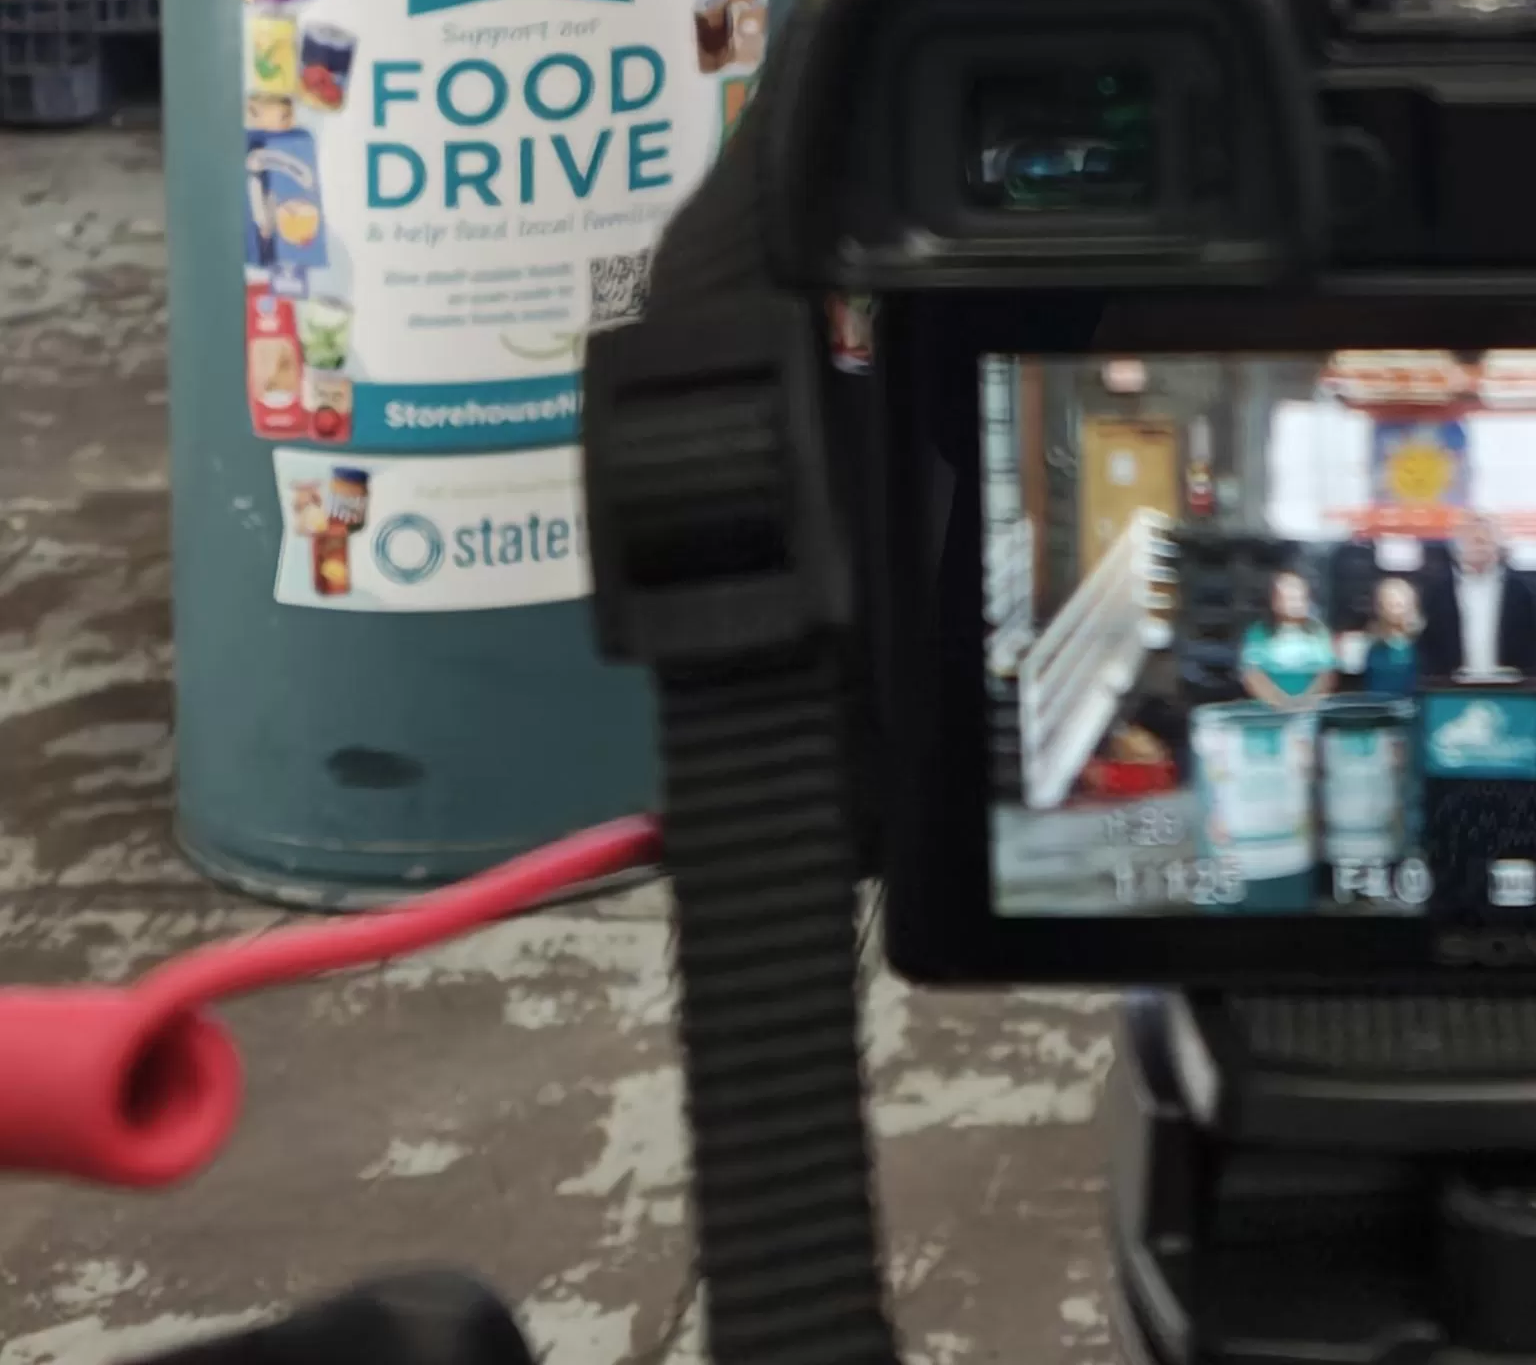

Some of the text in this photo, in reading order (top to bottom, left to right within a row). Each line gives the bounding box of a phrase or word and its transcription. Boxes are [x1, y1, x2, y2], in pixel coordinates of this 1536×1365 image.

[372, 45, 666, 127] FOOD
[366, 119, 673, 209] DRIVE
[393, 223, 447, 248] help
[519, 212, 574, 236] local
[385, 391, 583, 428] StorehouseN
[452, 512, 583, 568] state
